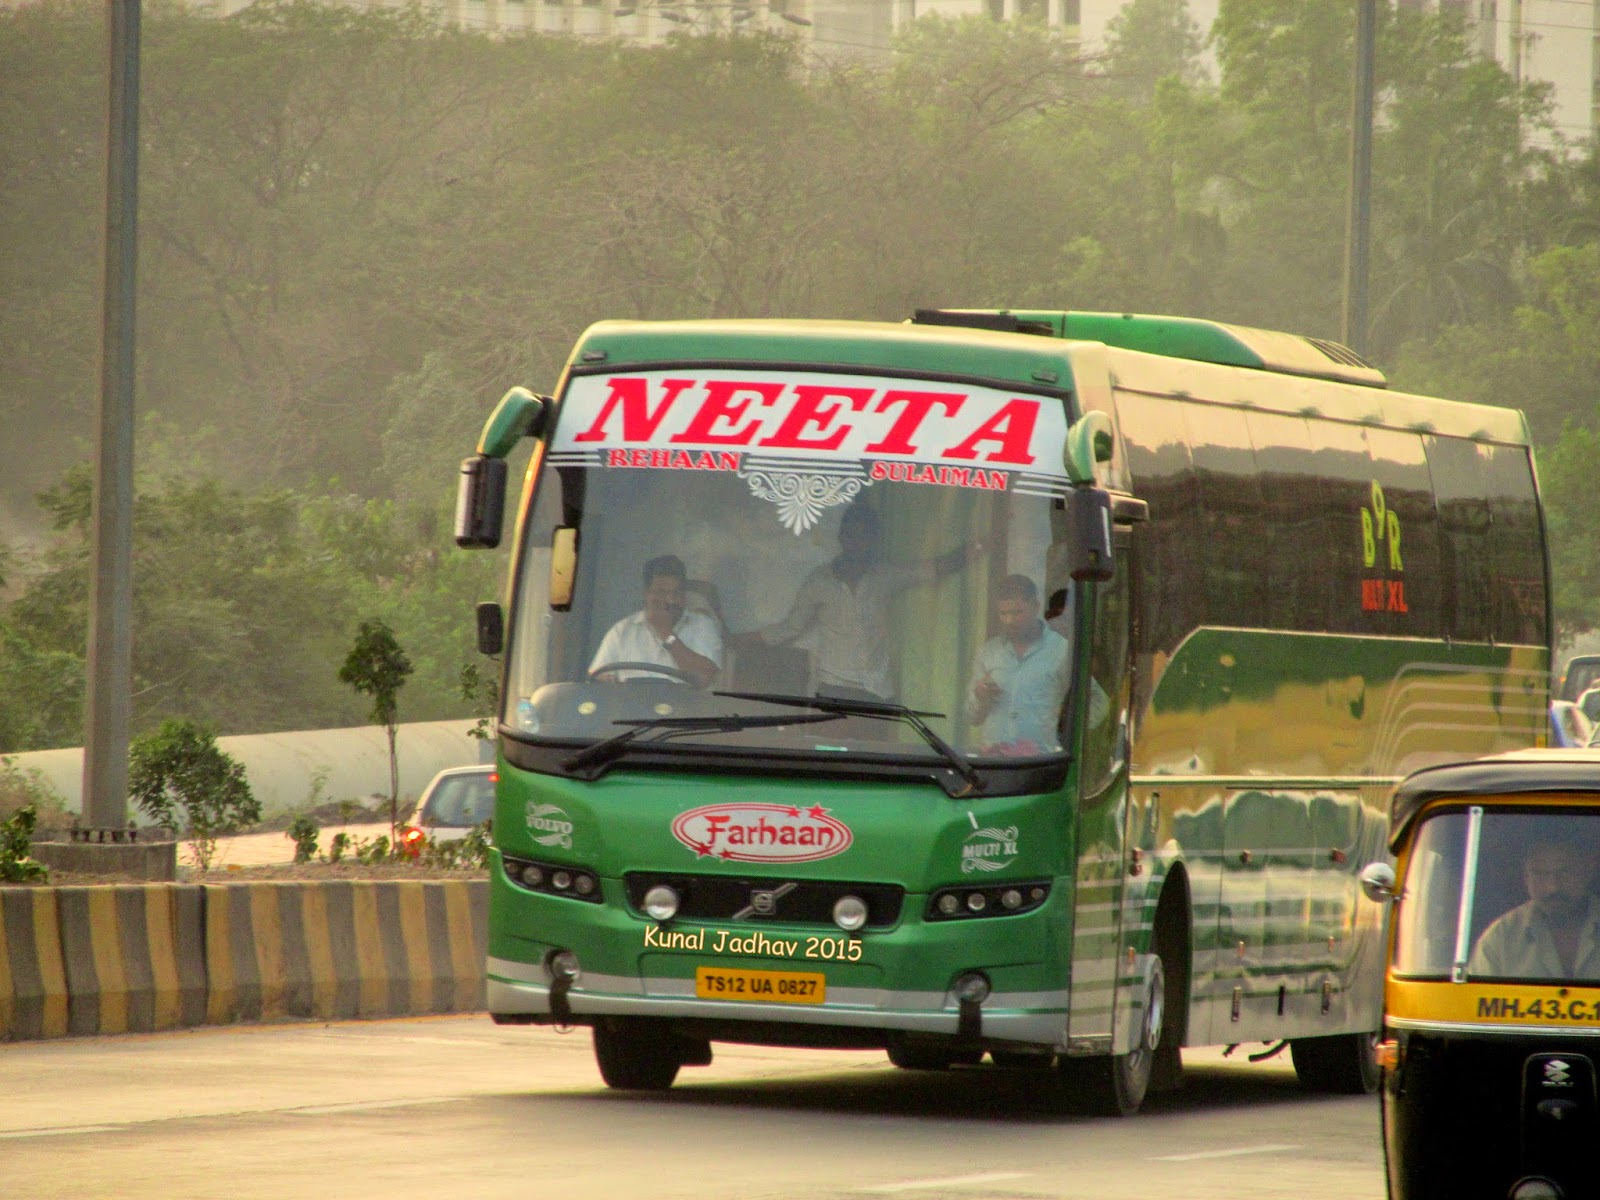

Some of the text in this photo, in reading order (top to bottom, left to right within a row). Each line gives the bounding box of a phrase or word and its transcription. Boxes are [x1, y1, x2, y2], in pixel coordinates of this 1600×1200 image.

[575, 378, 1042, 466] NEETA
[606, 448, 742, 472] REHAAN
[870, 459, 1010, 491] SULAIMAN
[704, 815, 834, 849] Farhaan
[1003, 841, 1018, 855] XL
[705, 976, 817, 996] TS12 UA 0827
